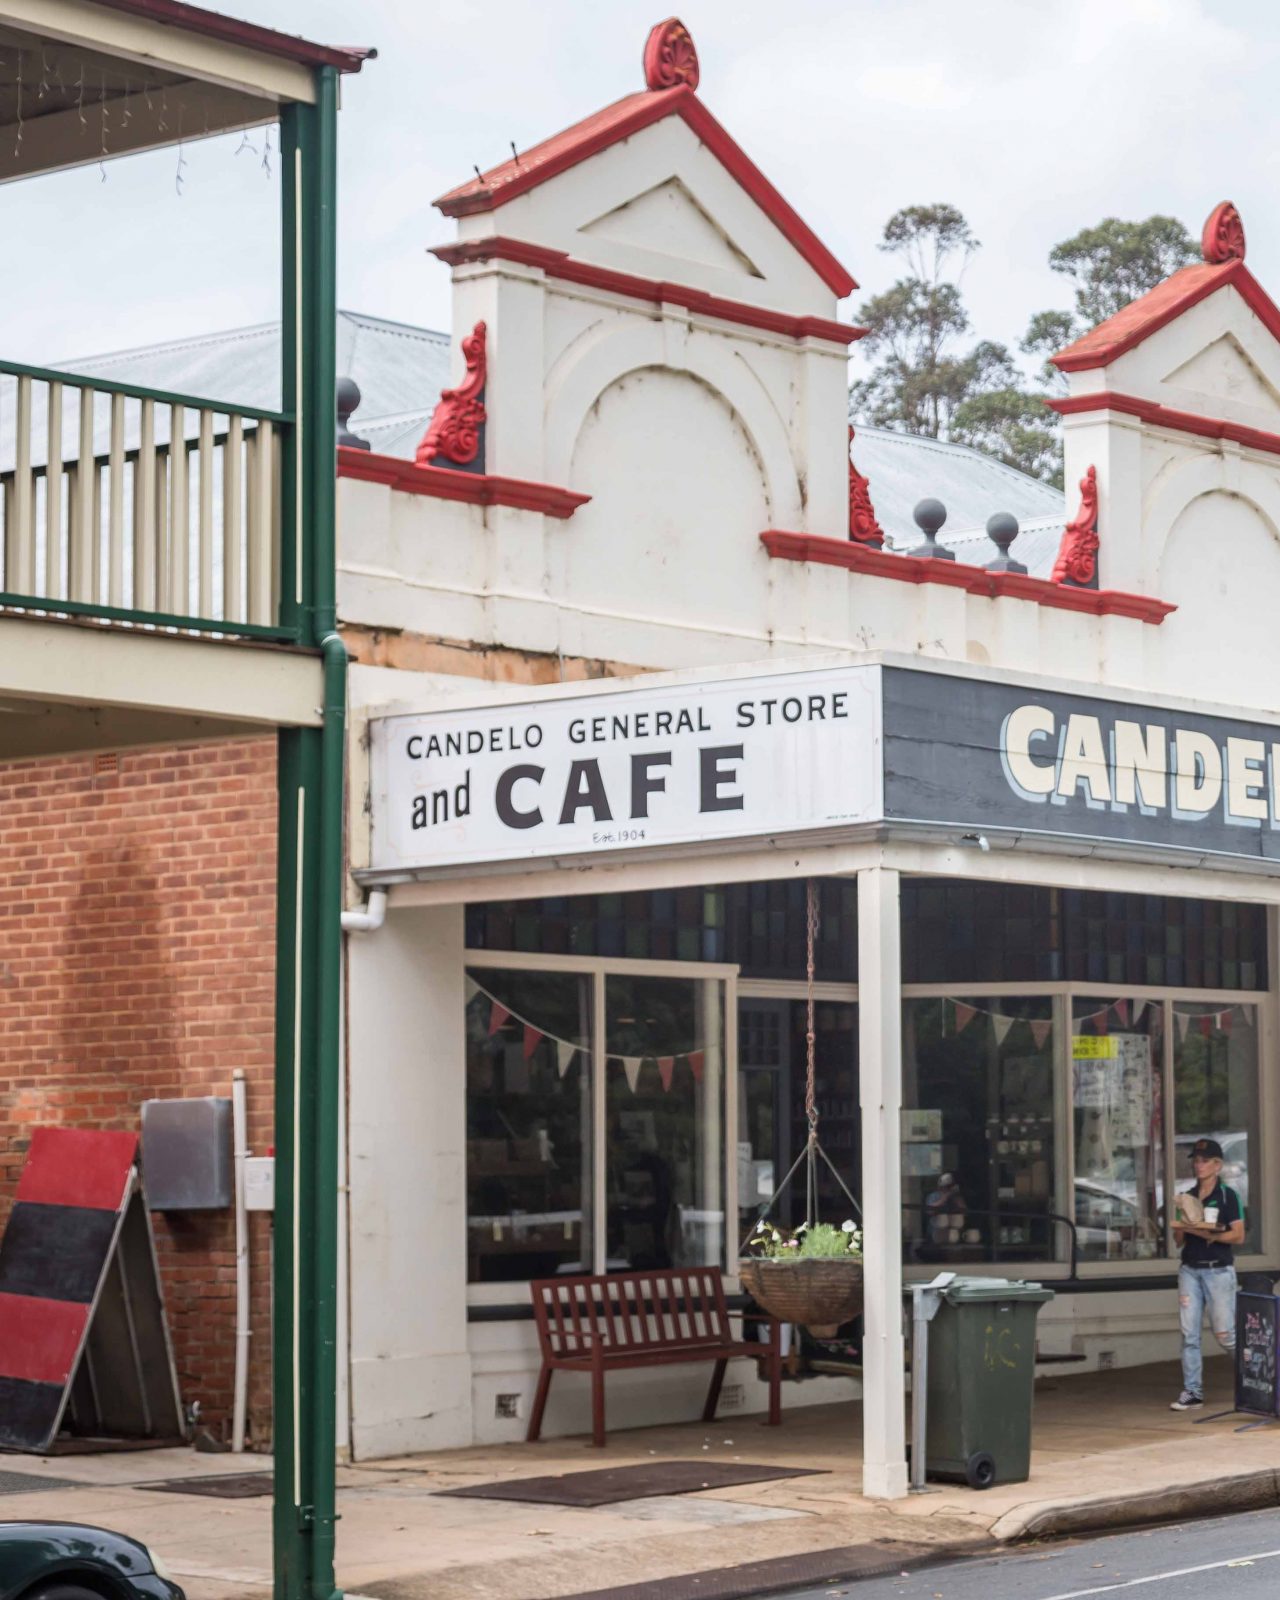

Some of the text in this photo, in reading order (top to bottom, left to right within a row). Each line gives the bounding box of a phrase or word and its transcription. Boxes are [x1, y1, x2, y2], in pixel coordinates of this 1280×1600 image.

[406, 692, 848, 760] CANDELO GENERAL STORE
[411, 743, 744, 830] and CAFE
[617, 829, 646, 842] 1904
